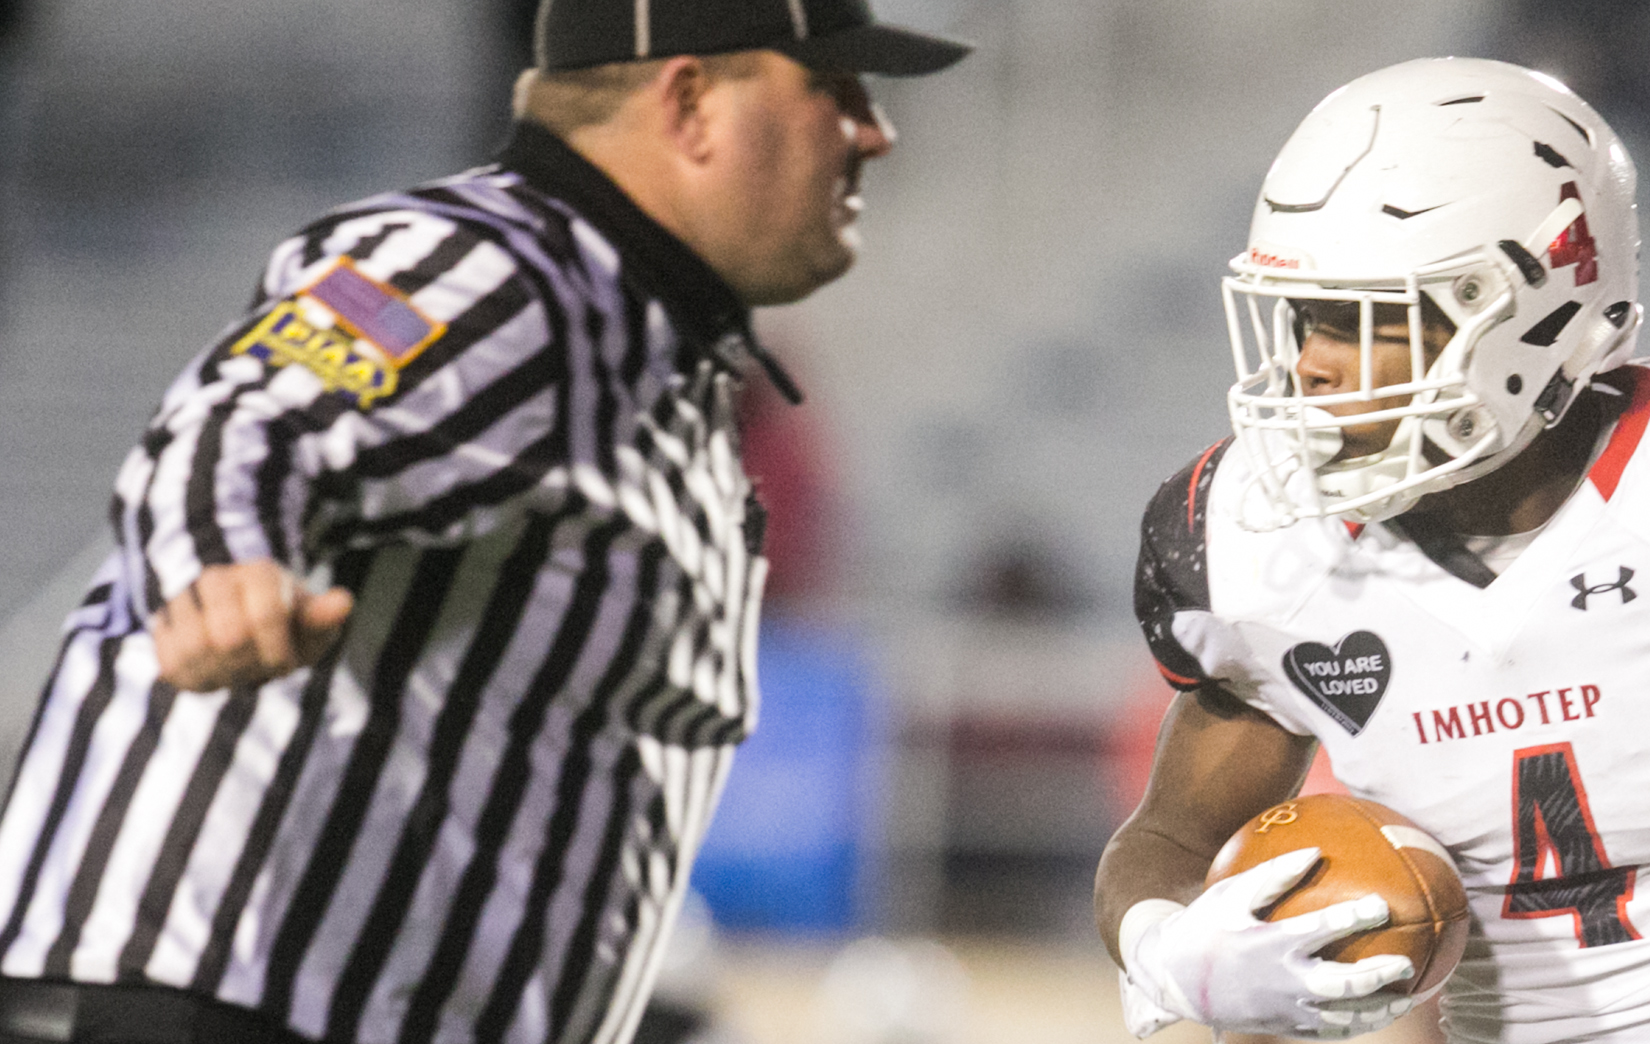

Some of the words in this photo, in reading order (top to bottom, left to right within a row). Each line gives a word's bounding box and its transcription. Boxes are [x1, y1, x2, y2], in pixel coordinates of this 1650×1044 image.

[1546, 180, 1599, 287] 4
[1303, 660, 1341, 677] YOU
[1343, 654, 1384, 675] ARE
[1319, 677, 1379, 695] LOVED
[1411, 683, 1602, 745] IMHOTEP
[1500, 741, 1643, 950] 4
